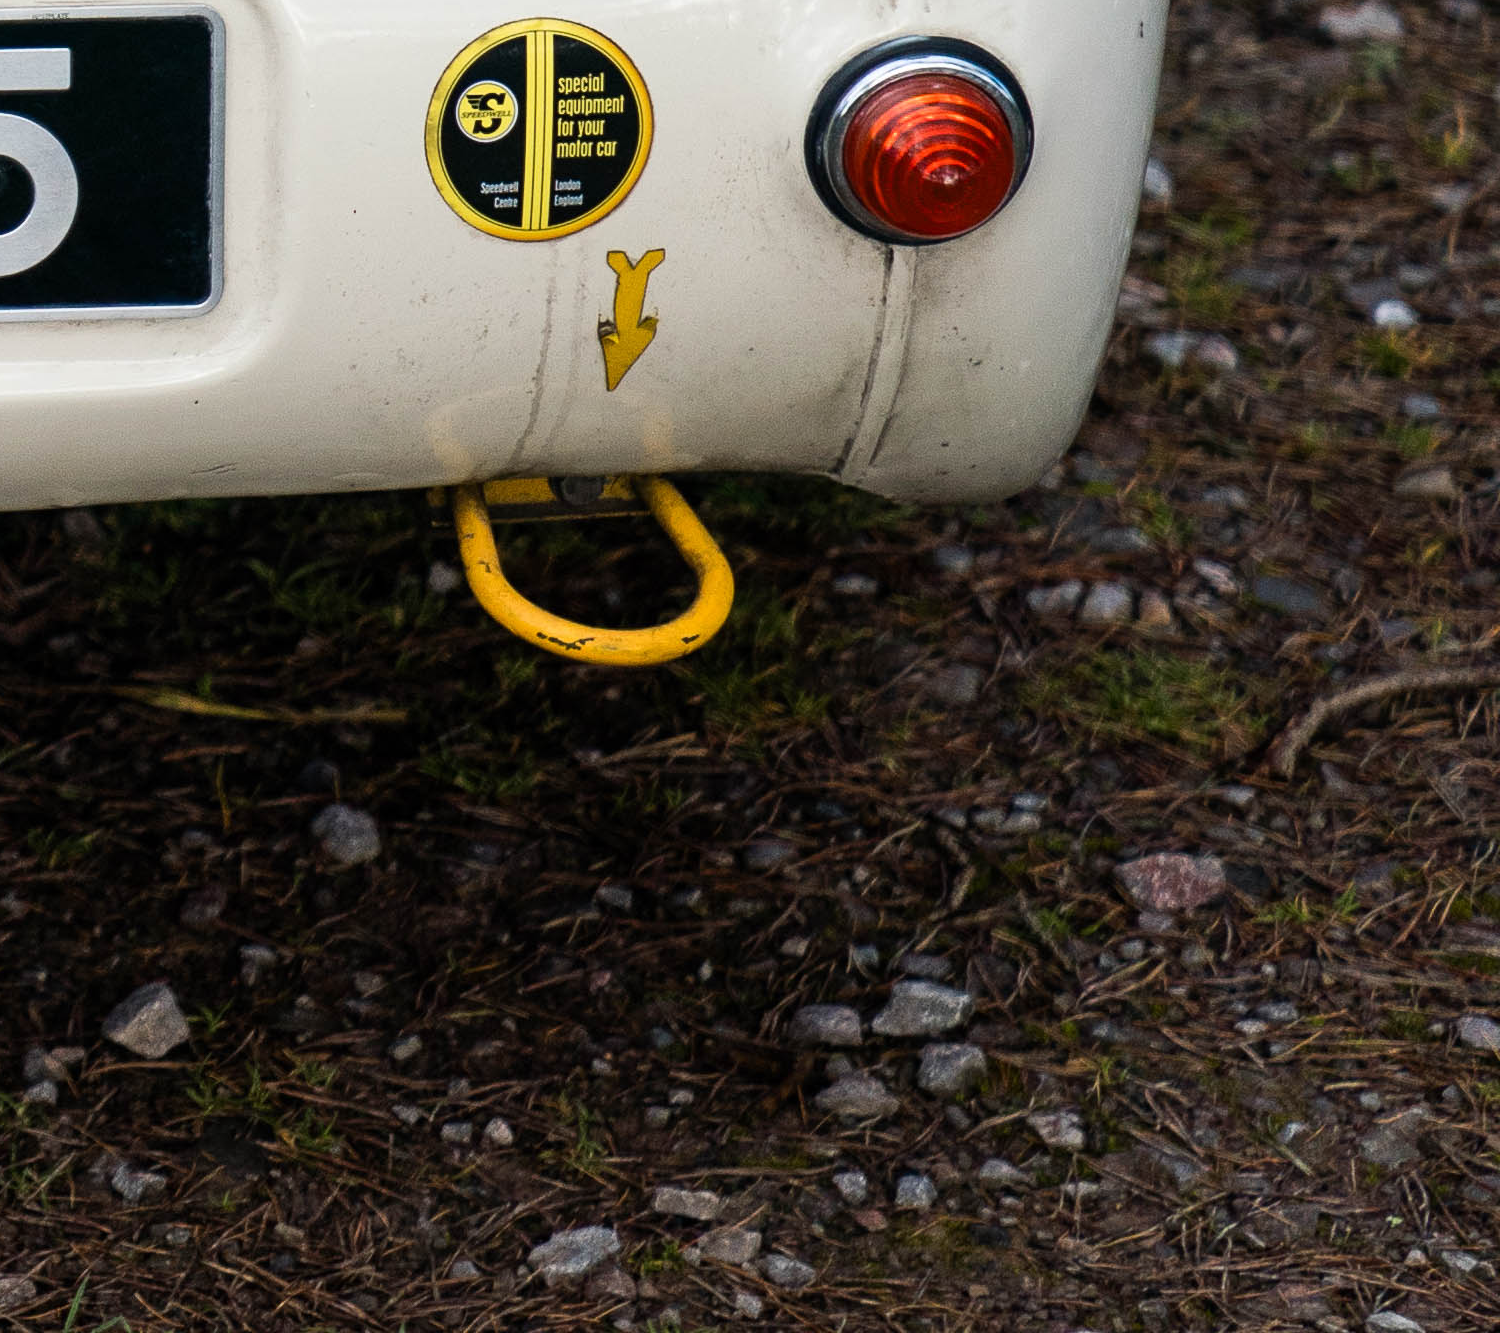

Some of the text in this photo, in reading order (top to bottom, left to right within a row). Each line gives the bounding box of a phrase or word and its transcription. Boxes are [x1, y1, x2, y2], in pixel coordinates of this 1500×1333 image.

[558, 72, 605, 95] special
[558, 94, 625, 117] equipment
[460, 110, 513, 119] SPEEDWELL
[557, 117, 606, 138] for your
[556, 139, 618, 158] motor car
[480, 180, 519, 195] Speedwell
[555, 179, 581, 192] London
[493, 196, 519, 209] Centre
[553, 193, 584, 207] England
